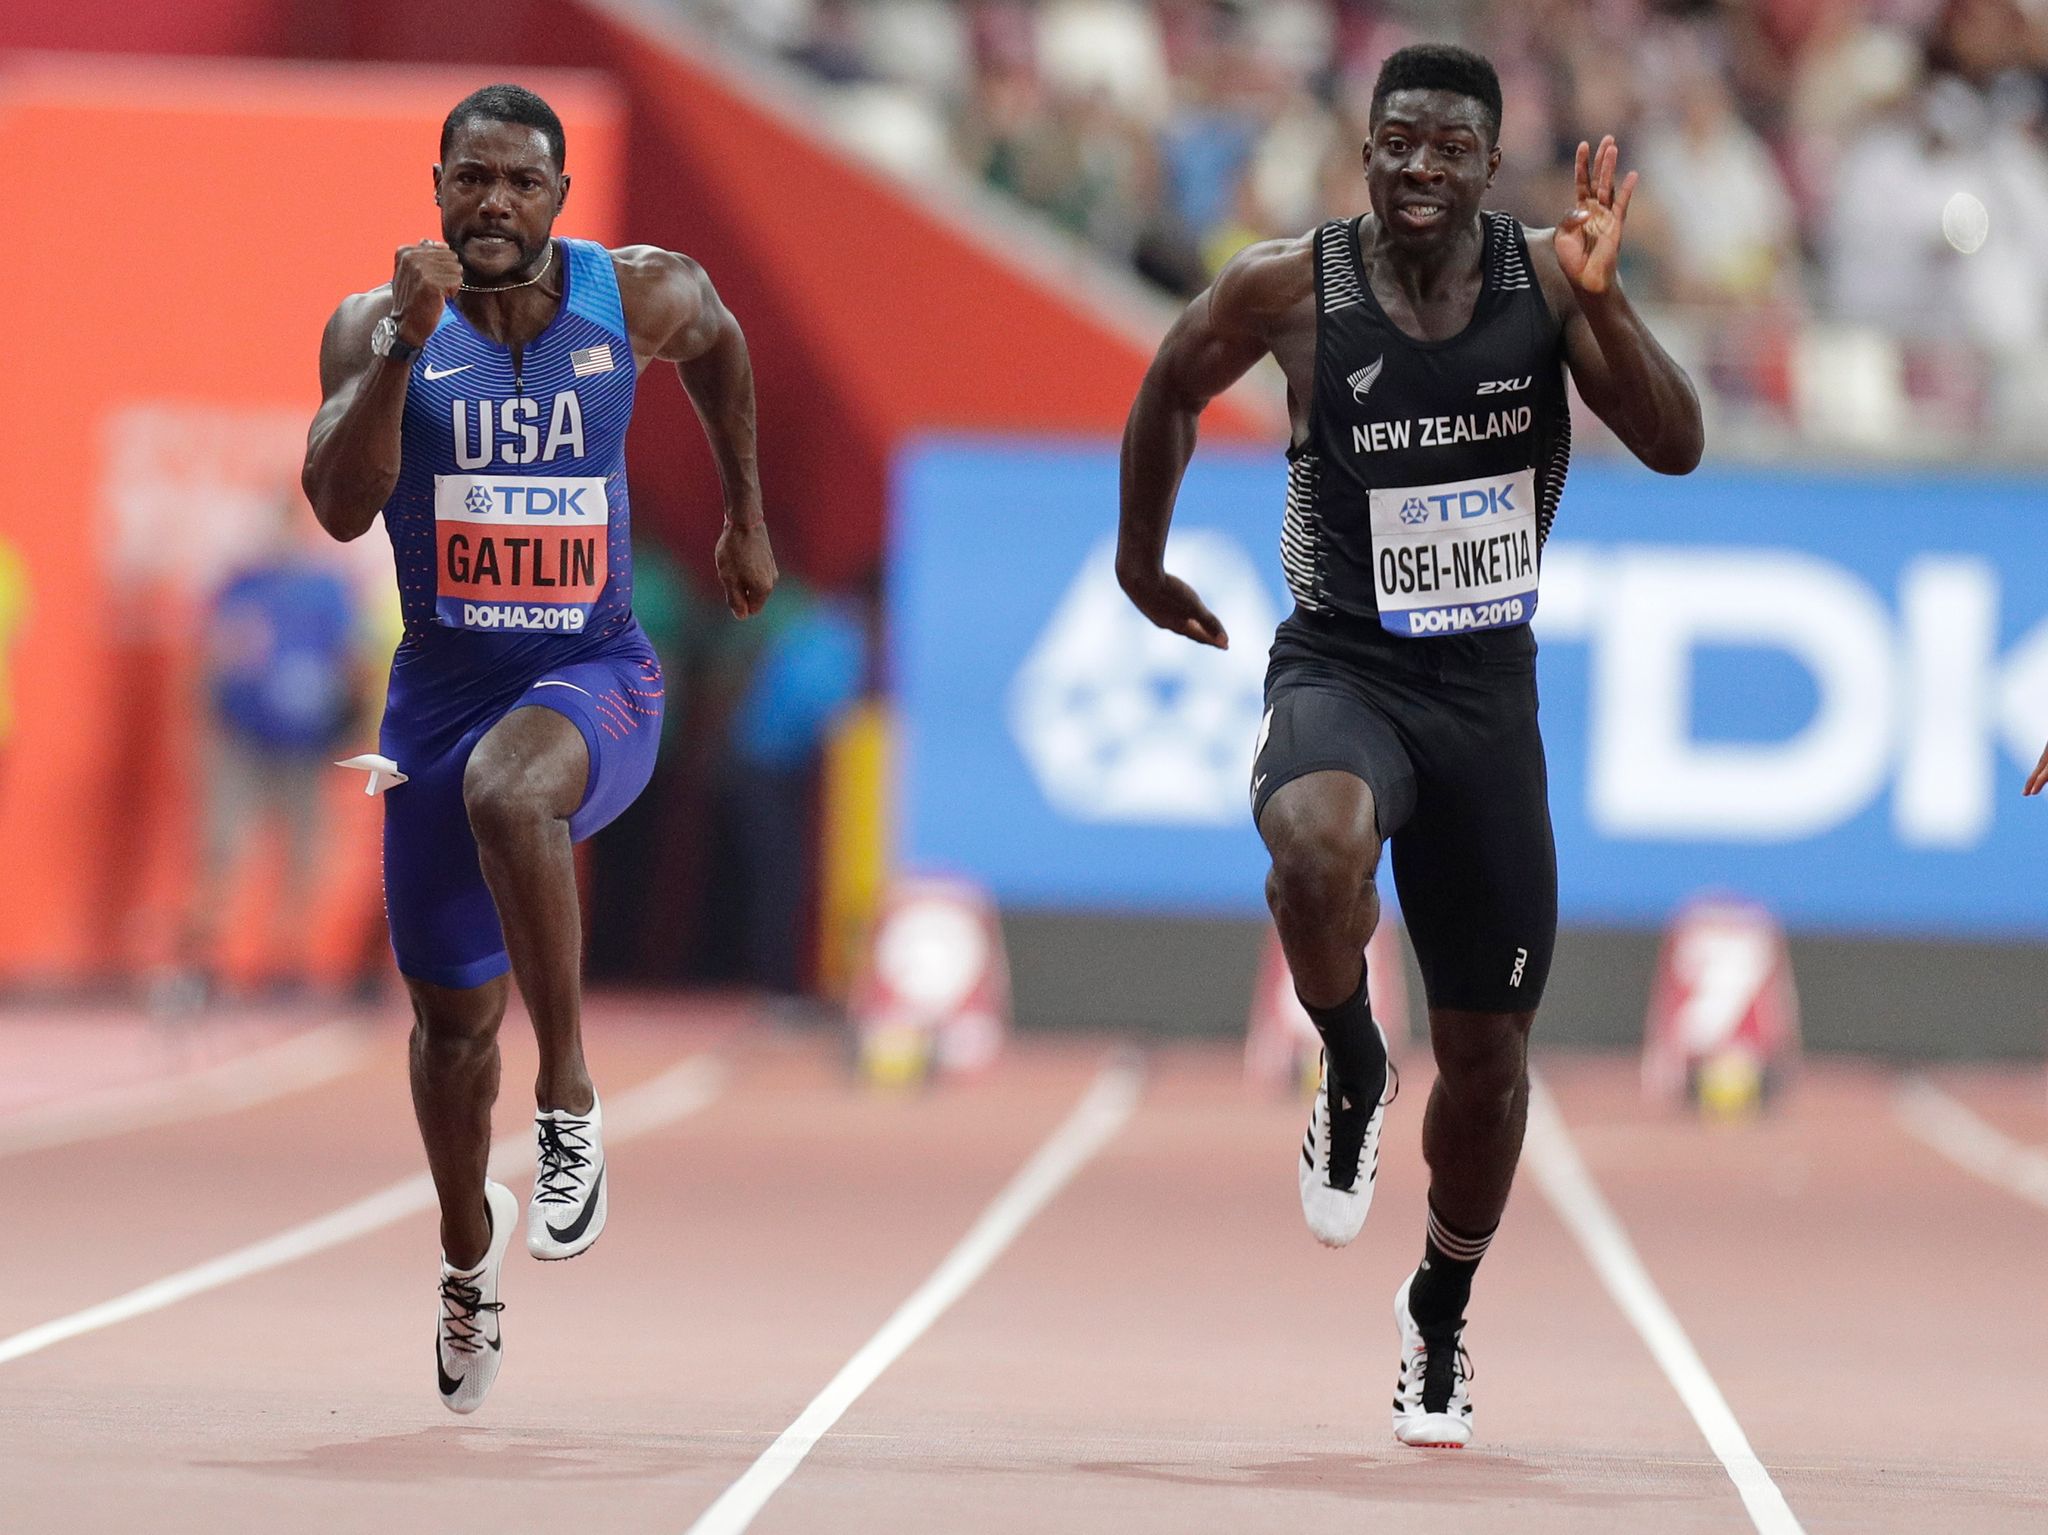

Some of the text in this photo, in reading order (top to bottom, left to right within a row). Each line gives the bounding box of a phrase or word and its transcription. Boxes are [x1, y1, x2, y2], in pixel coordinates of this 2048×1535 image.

[1476, 375, 1532, 396] 2XU
[452, 389, 585, 470] USA
[1352, 405, 1532, 453] NEW ZEALAND
[492, 486, 587, 516] TDK
[1427, 483, 1515, 523] TDK
[447, 533, 595, 587] GATLIN
[1379, 529, 1533, 596] OSEI-NKETIA
[463, 603, 584, 630] DOHA2019
[1409, 598, 1524, 634] DOHA2019
[1509, 947, 1528, 988] 2XU
